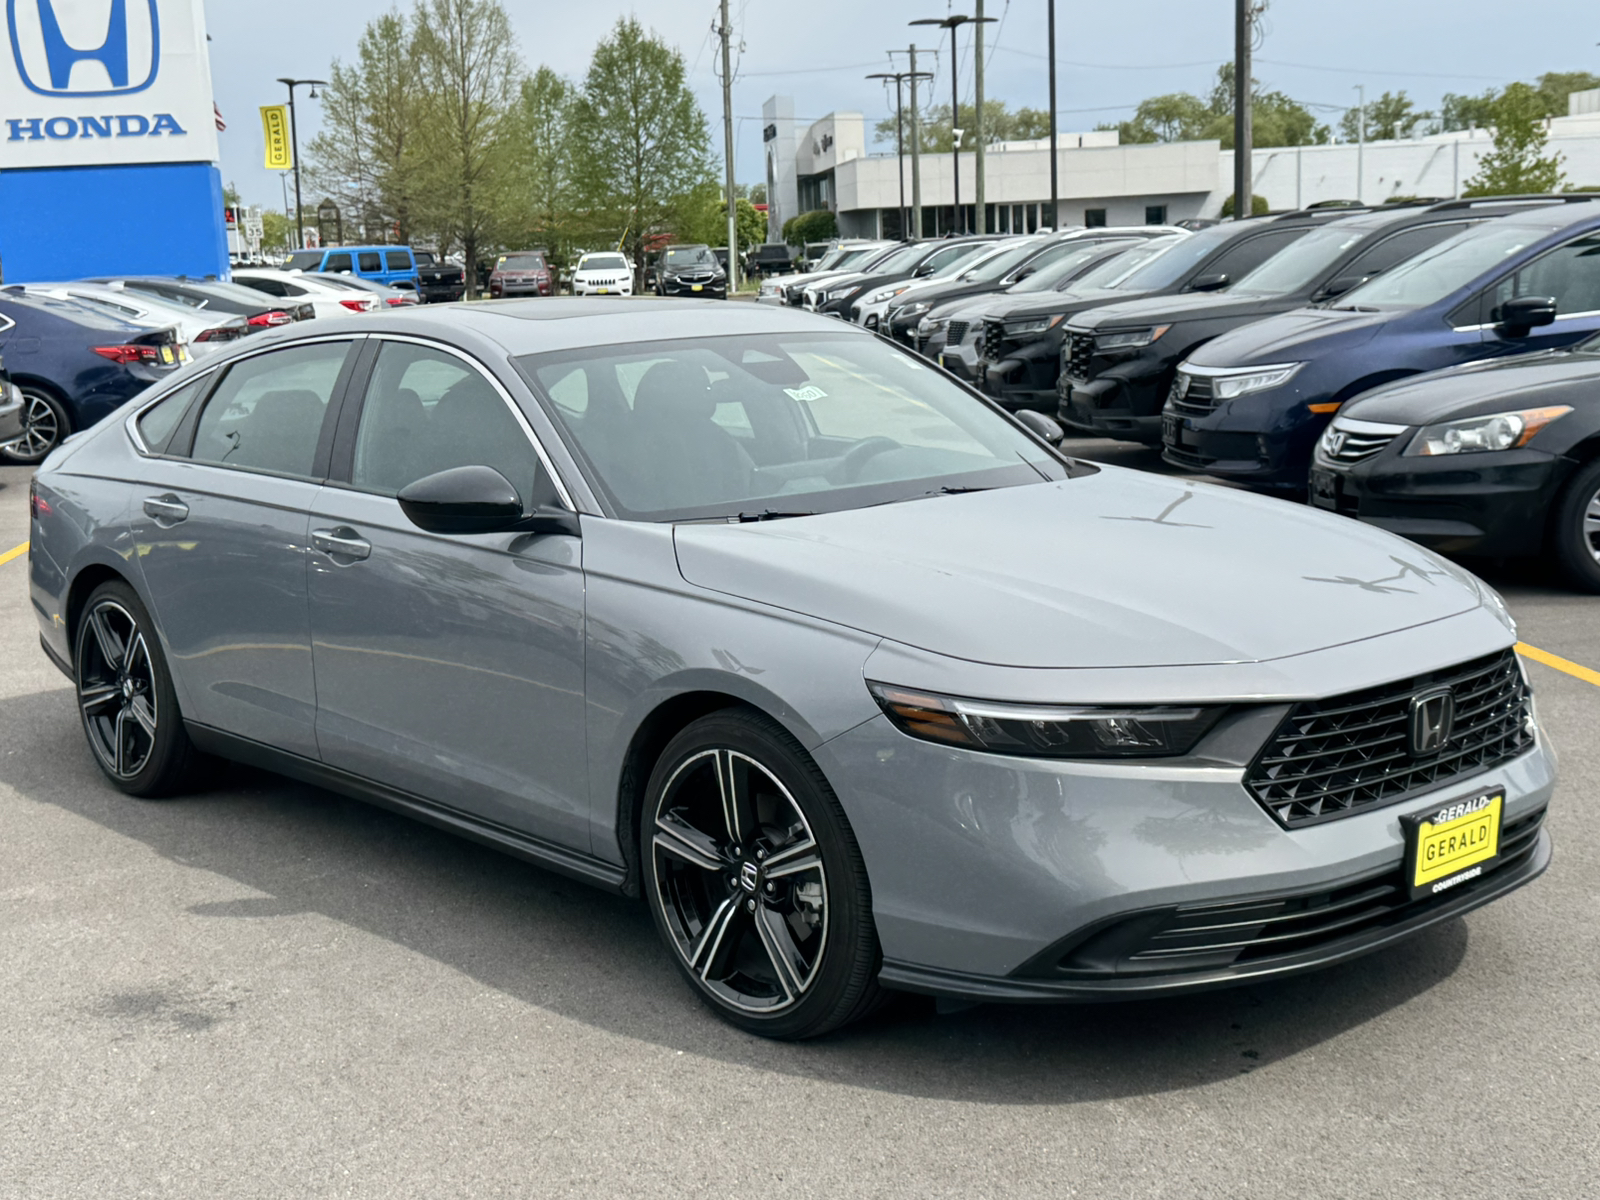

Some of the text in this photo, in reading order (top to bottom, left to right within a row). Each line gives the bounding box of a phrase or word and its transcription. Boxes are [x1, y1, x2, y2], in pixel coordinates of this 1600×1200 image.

[6, 114, 187, 140] HONDA
[270, 113, 282, 160] GERALD
[248, 228, 262, 236] 35
[1438, 796, 1487, 823] GERALD
[1427, 825, 1486, 861] GERALD
[1432, 867, 1481, 893] COUNTRYSIDE
